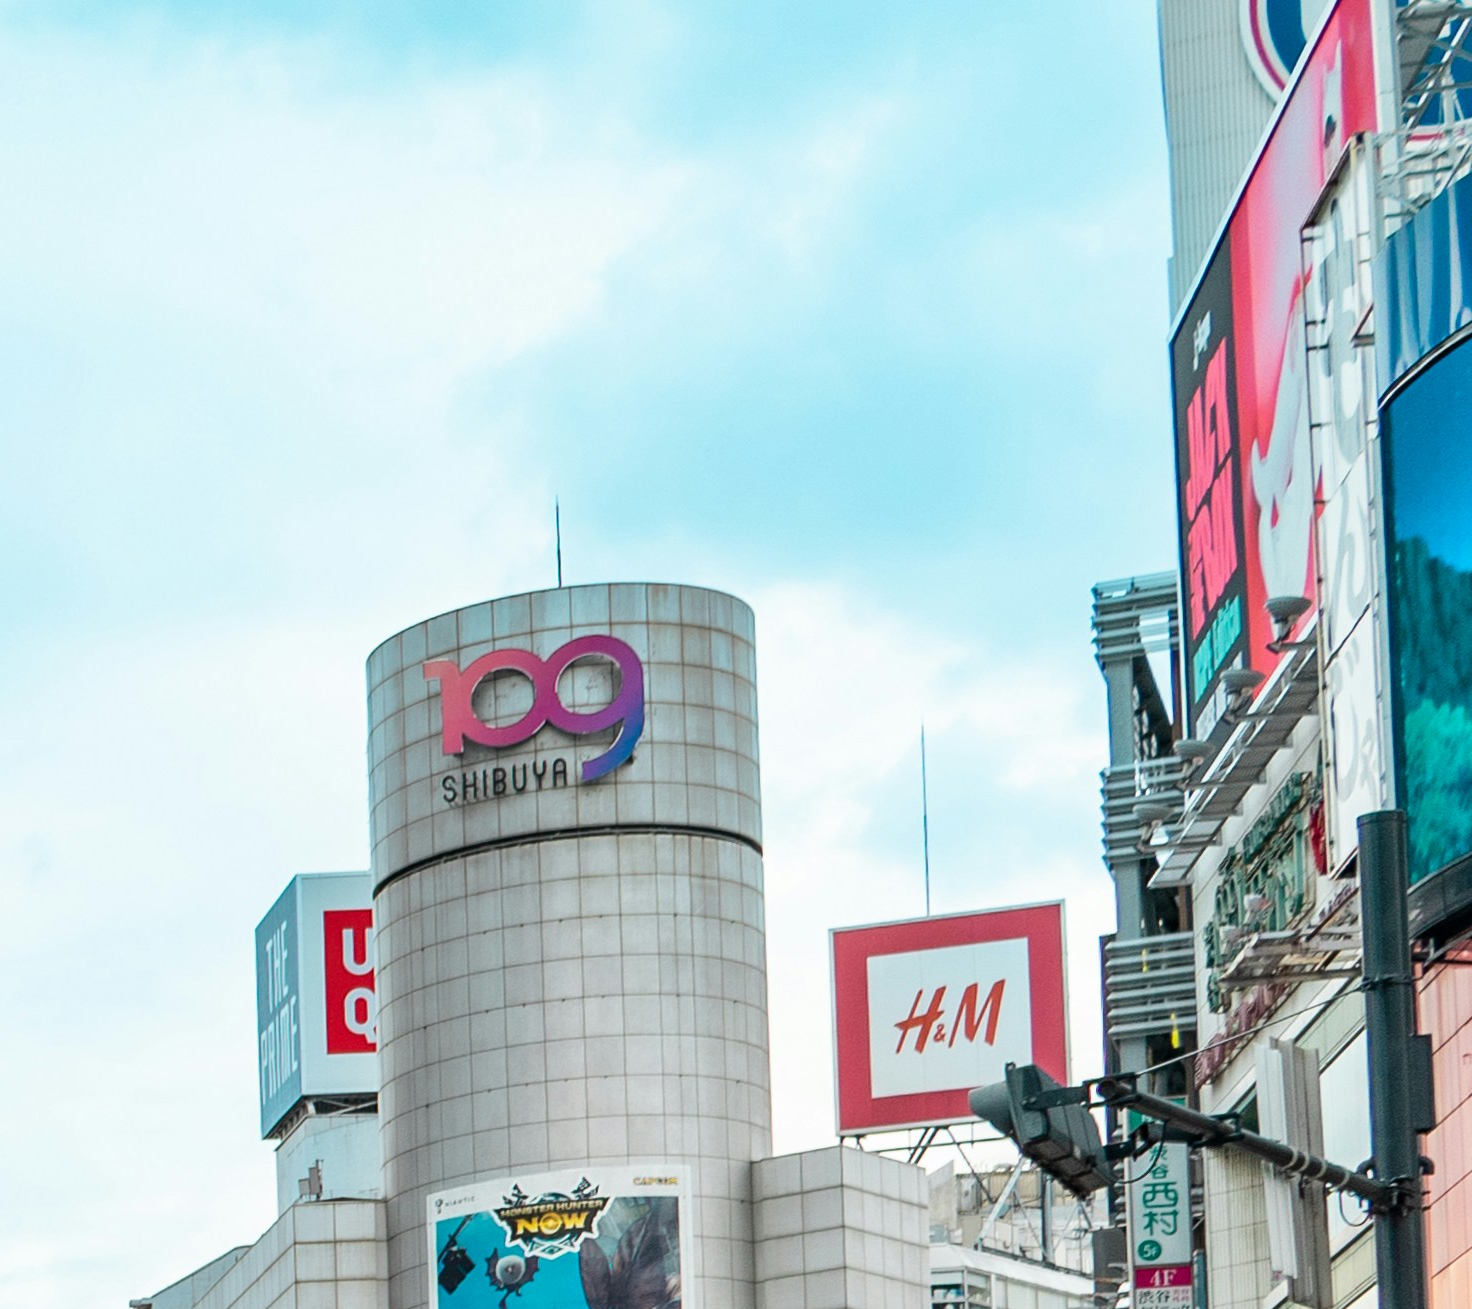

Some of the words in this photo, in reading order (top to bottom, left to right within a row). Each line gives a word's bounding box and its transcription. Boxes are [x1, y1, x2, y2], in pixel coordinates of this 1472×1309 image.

[423, 634, 646, 783] 109
[442, 756, 569, 804] SHIBUYA
[265, 921, 291, 995] THE
[894, 978, 1007, 1056] H&M
[260, 995, 299, 1104] PRIME
[633, 1176, 679, 1186] CAPCOM
[501, 1202, 554, 1218] MONSTER
[556, 1199, 604, 1212] HUNTER
[515, 1211, 589, 1236] NOW
[1143, 1244, 1158, 1257] 5F
[1150, 1269, 1177, 1287] 4F
[1139, 1289, 1172, 1307] 渋谷
